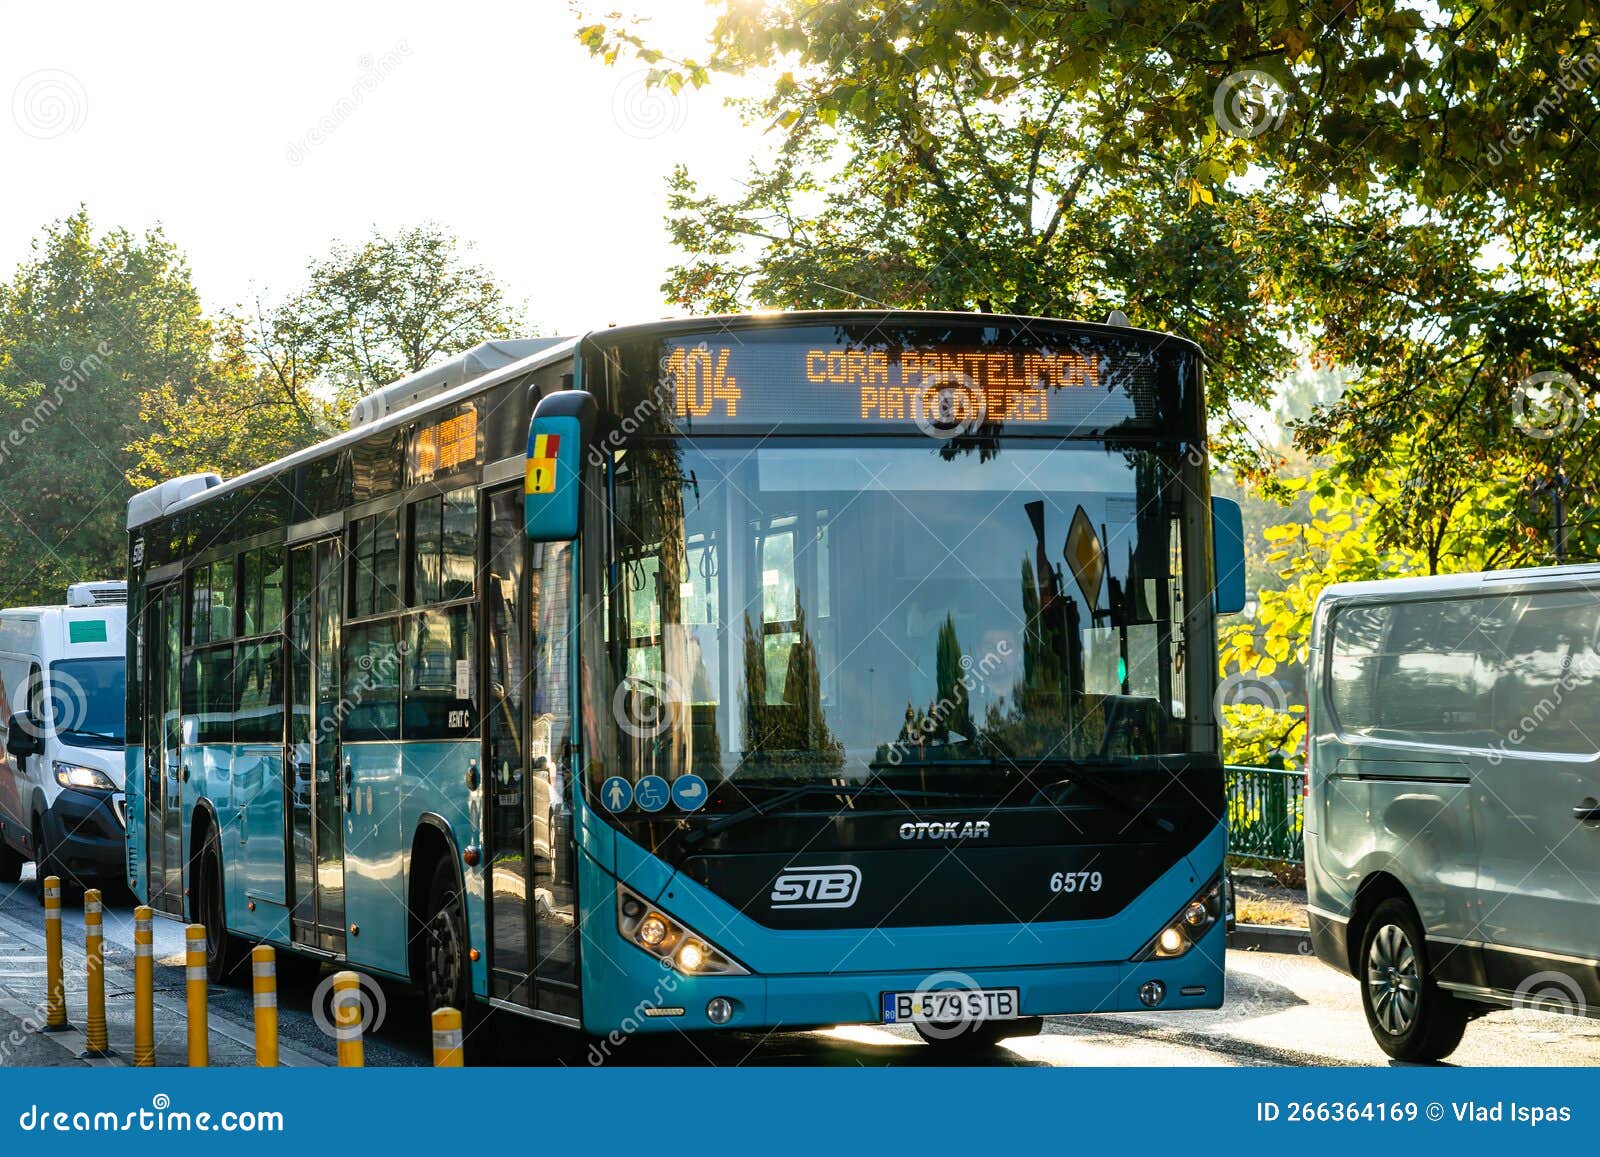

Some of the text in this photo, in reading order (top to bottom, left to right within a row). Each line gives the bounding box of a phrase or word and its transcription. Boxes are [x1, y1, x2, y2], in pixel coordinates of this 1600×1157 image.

[806, 350, 1099, 387] CORA PANTELIMON
[667, 347, 742, 417] 104
[448, 709, 469, 728] KENT C
[899, 821, 991, 840] OTOKAR
[770, 871, 855, 902] STB
[1050, 871, 1102, 893] 6579
[885, 1010, 895, 1019] RO
[898, 992, 1013, 1019] B 579 STB
